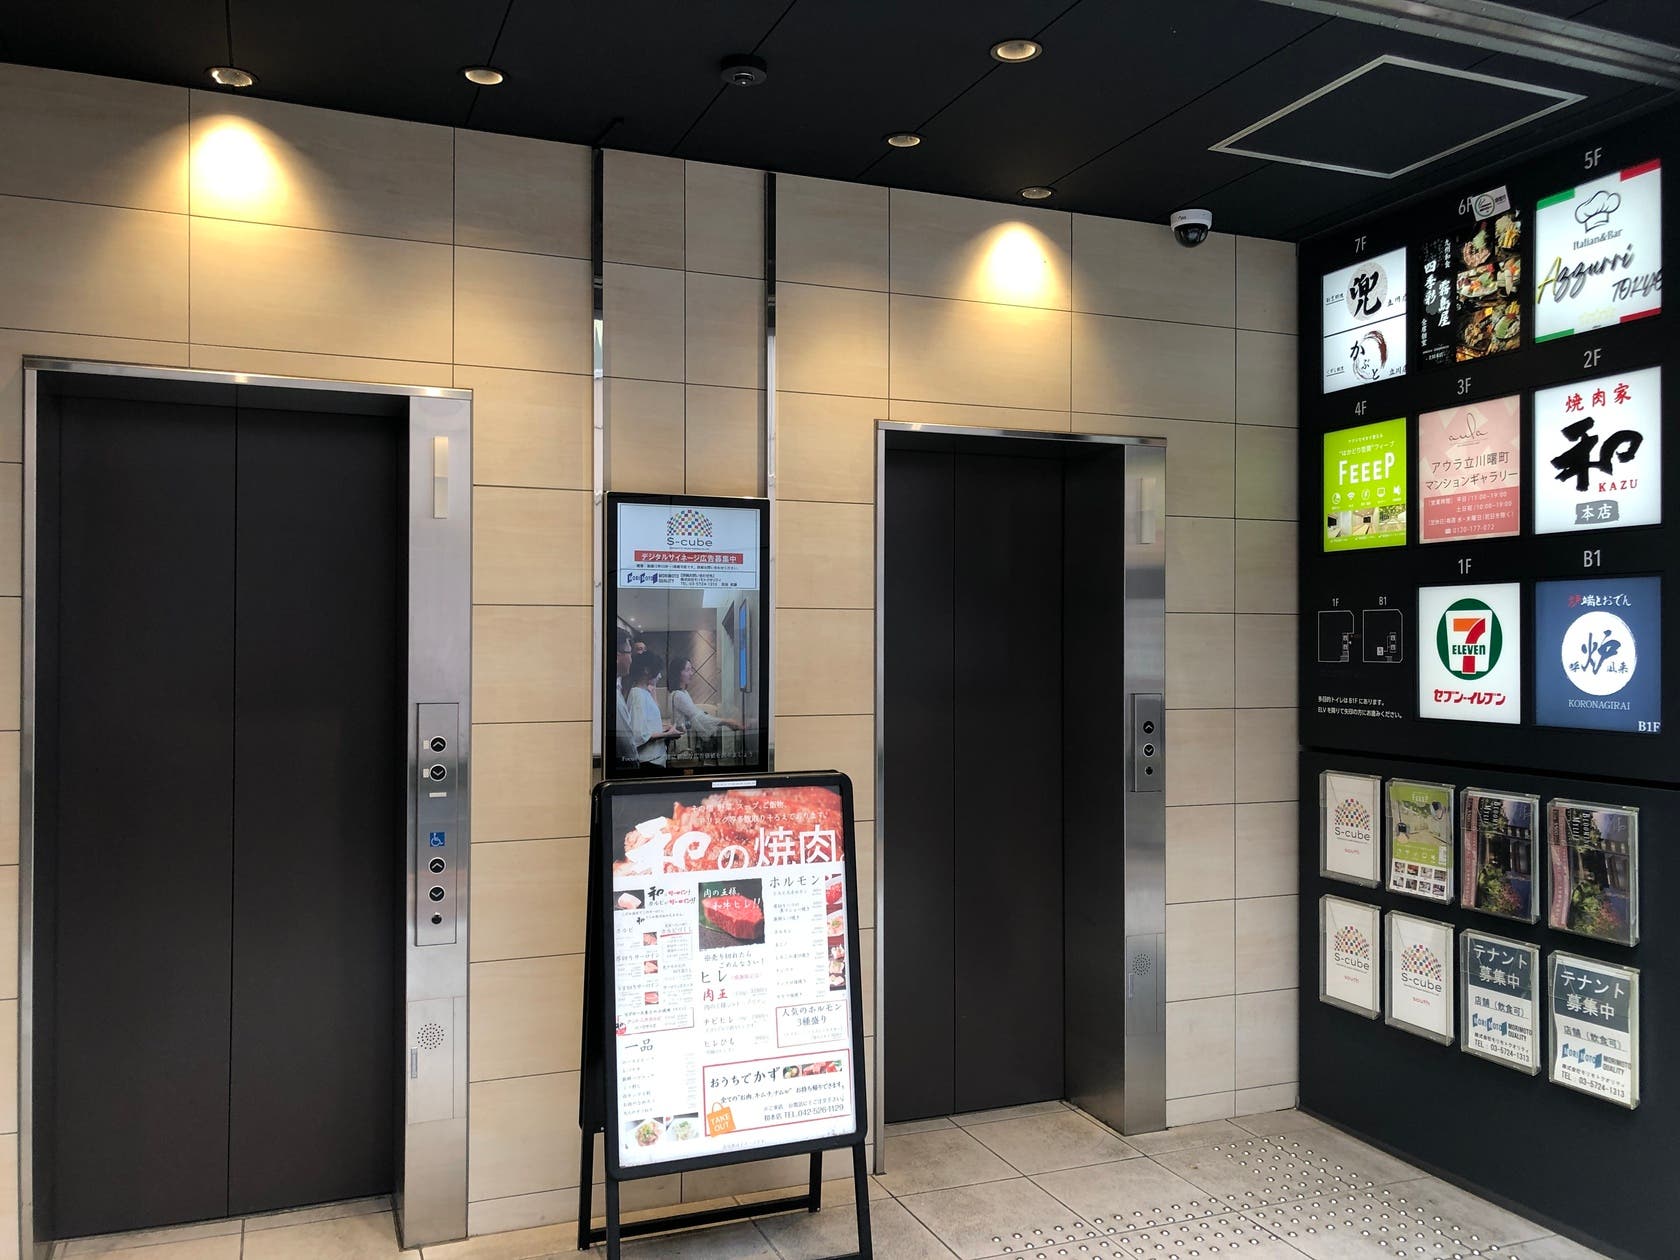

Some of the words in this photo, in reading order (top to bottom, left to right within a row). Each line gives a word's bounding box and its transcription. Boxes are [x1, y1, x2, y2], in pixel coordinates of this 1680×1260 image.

[1584, 147, 1602, 169] 5F
[1355, 236, 1367, 253] 7F
[1573, 228, 1623, 250] Italian&Bar
[1537, 243, 1635, 304] Azzurri
[1349, 271, 1382, 317] 兜
[1583, 348, 1602, 368] 2F
[1457, 377, 1472, 395] 3F
[1565, 383, 1632, 412] 焼肉家
[1354, 400, 1367, 415] 4F
[1431, 451, 1510, 474] アウラ立川曙町
[1550, 416, 1643, 492] 和
[1338, 452, 1395, 485] FEEEP
[1425, 470, 1518, 490] マンションギャラリー
[1598, 479, 1639, 492] KAZU
[1581, 503, 1613, 521] 本店
[667, 536, 713, 547] S-cube
[1458, 558, 1472, 575] 1F
[1583, 550, 1601, 568] B1
[1453, 618, 1486, 674] 7
[1568, 699, 1631, 711] KORONAGIRAI
[1638, 720, 1661, 733] B1F
[1334, 826, 1371, 841] S-cube
[769, 875, 820, 888] ホルモン
[1334, 952, 1370, 971] S-cube
[1473, 944, 1528, 969] テナント
[701, 970, 728, 983] ヒレ
[1401, 972, 1443, 993] S-cube
[1479, 965, 1520, 989] 募集中
[1560, 971, 1625, 999] テナント
[703, 988, 729, 1002] 肉王
[782, 1003, 843, 1017] 人気のホルモン
[1566, 993, 1615, 1020] 募集中
[798, 1015, 827, 1027] 3種盛り
[624, 1038, 654, 1053] 一品
[1490, 1043, 1530, 1062] 03-5724-1313
[710, 1066, 781, 1089] おうちでかず
[1578, 1076, 1625, 1098] 03-5724-1313
[710, 1113, 730, 1125] TAKE
[714, 1123, 729, 1132] OUT
